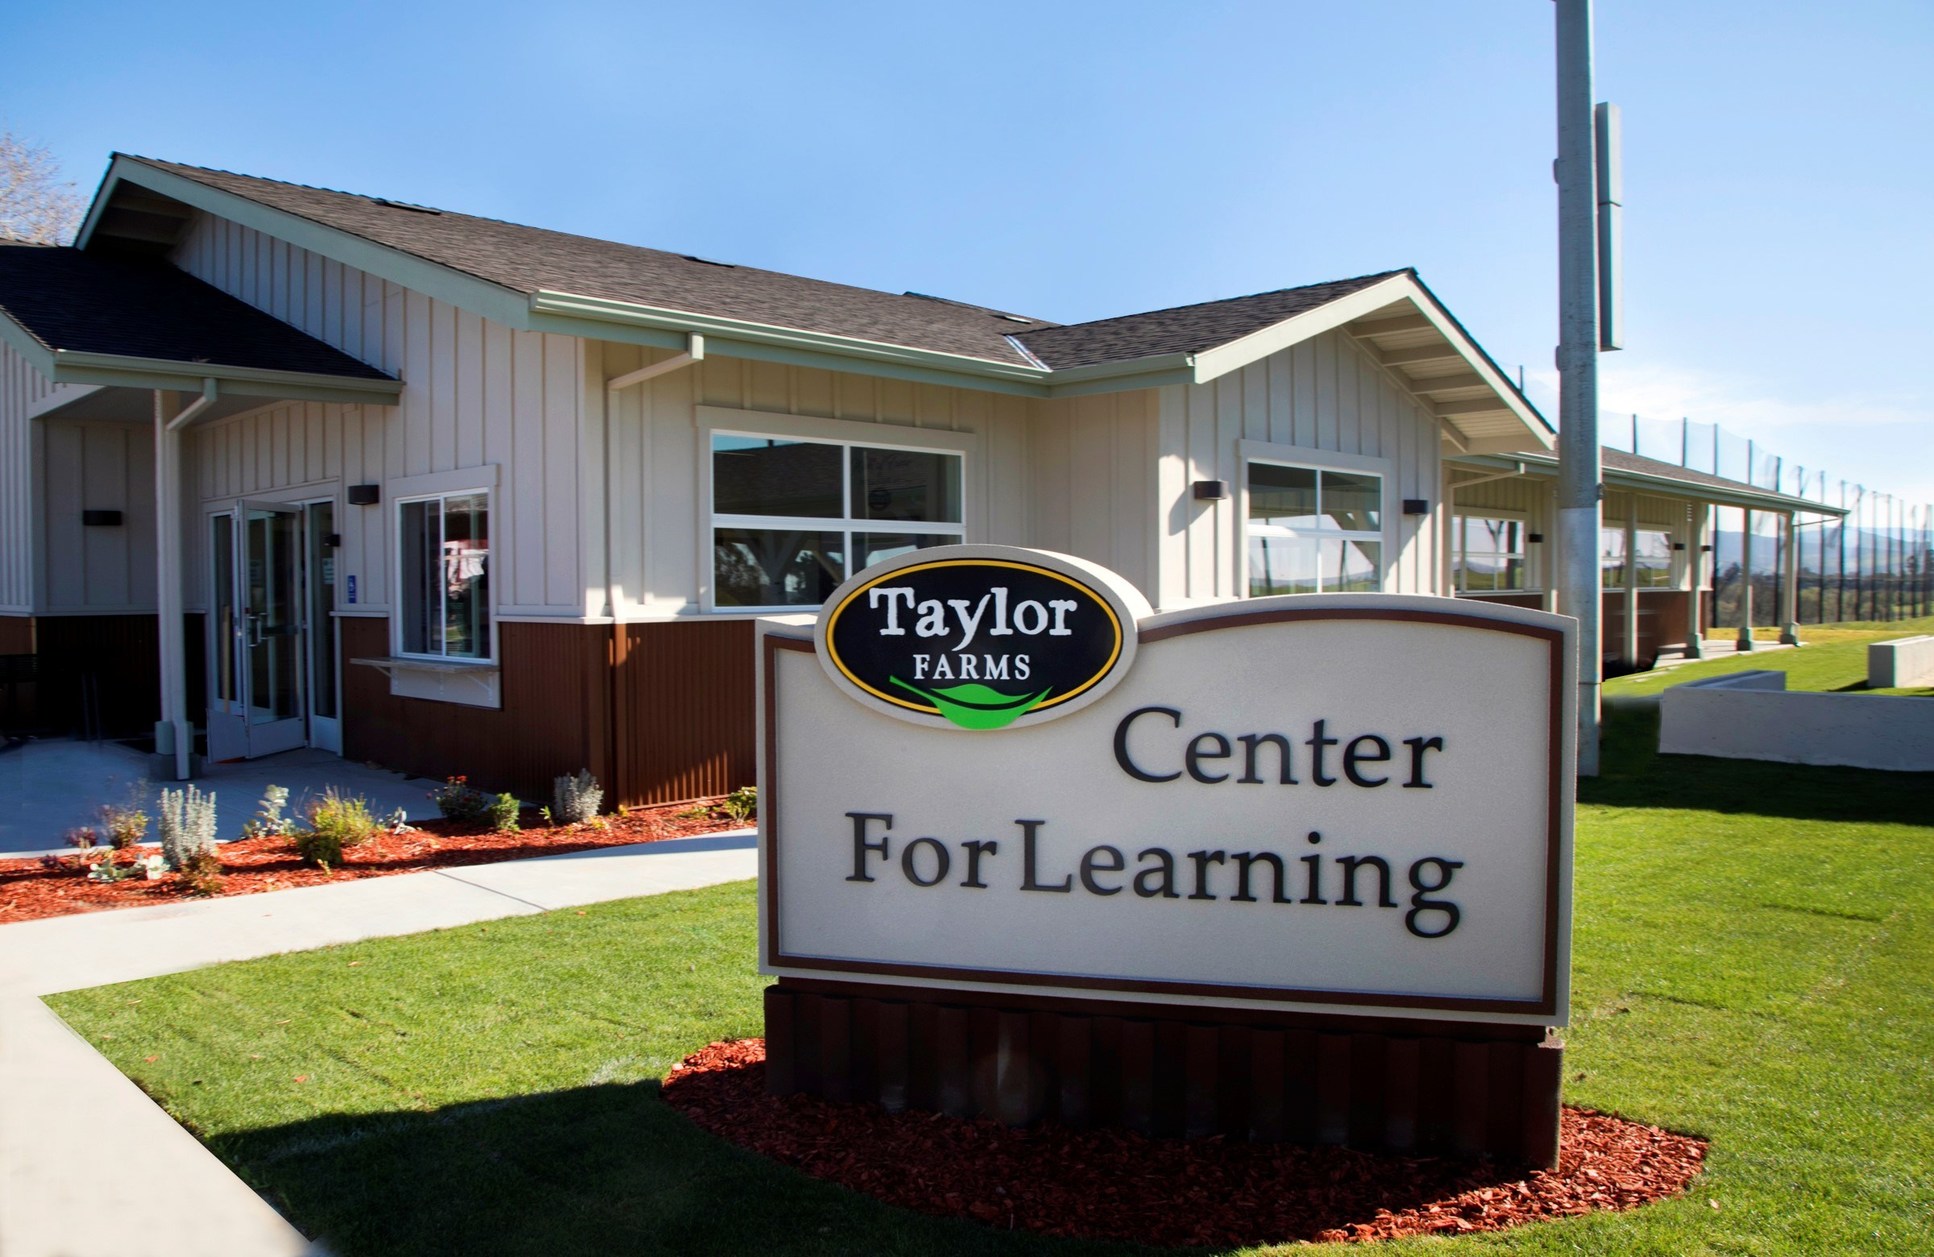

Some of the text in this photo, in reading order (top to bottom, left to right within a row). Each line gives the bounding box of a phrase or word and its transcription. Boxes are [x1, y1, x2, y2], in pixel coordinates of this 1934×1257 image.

[868, 586, 1078, 652] Taylor
[912, 653, 1031, 681] FARMS
[1112, 705, 1446, 790] Center
[844, 811, 1466, 940] For Learning
